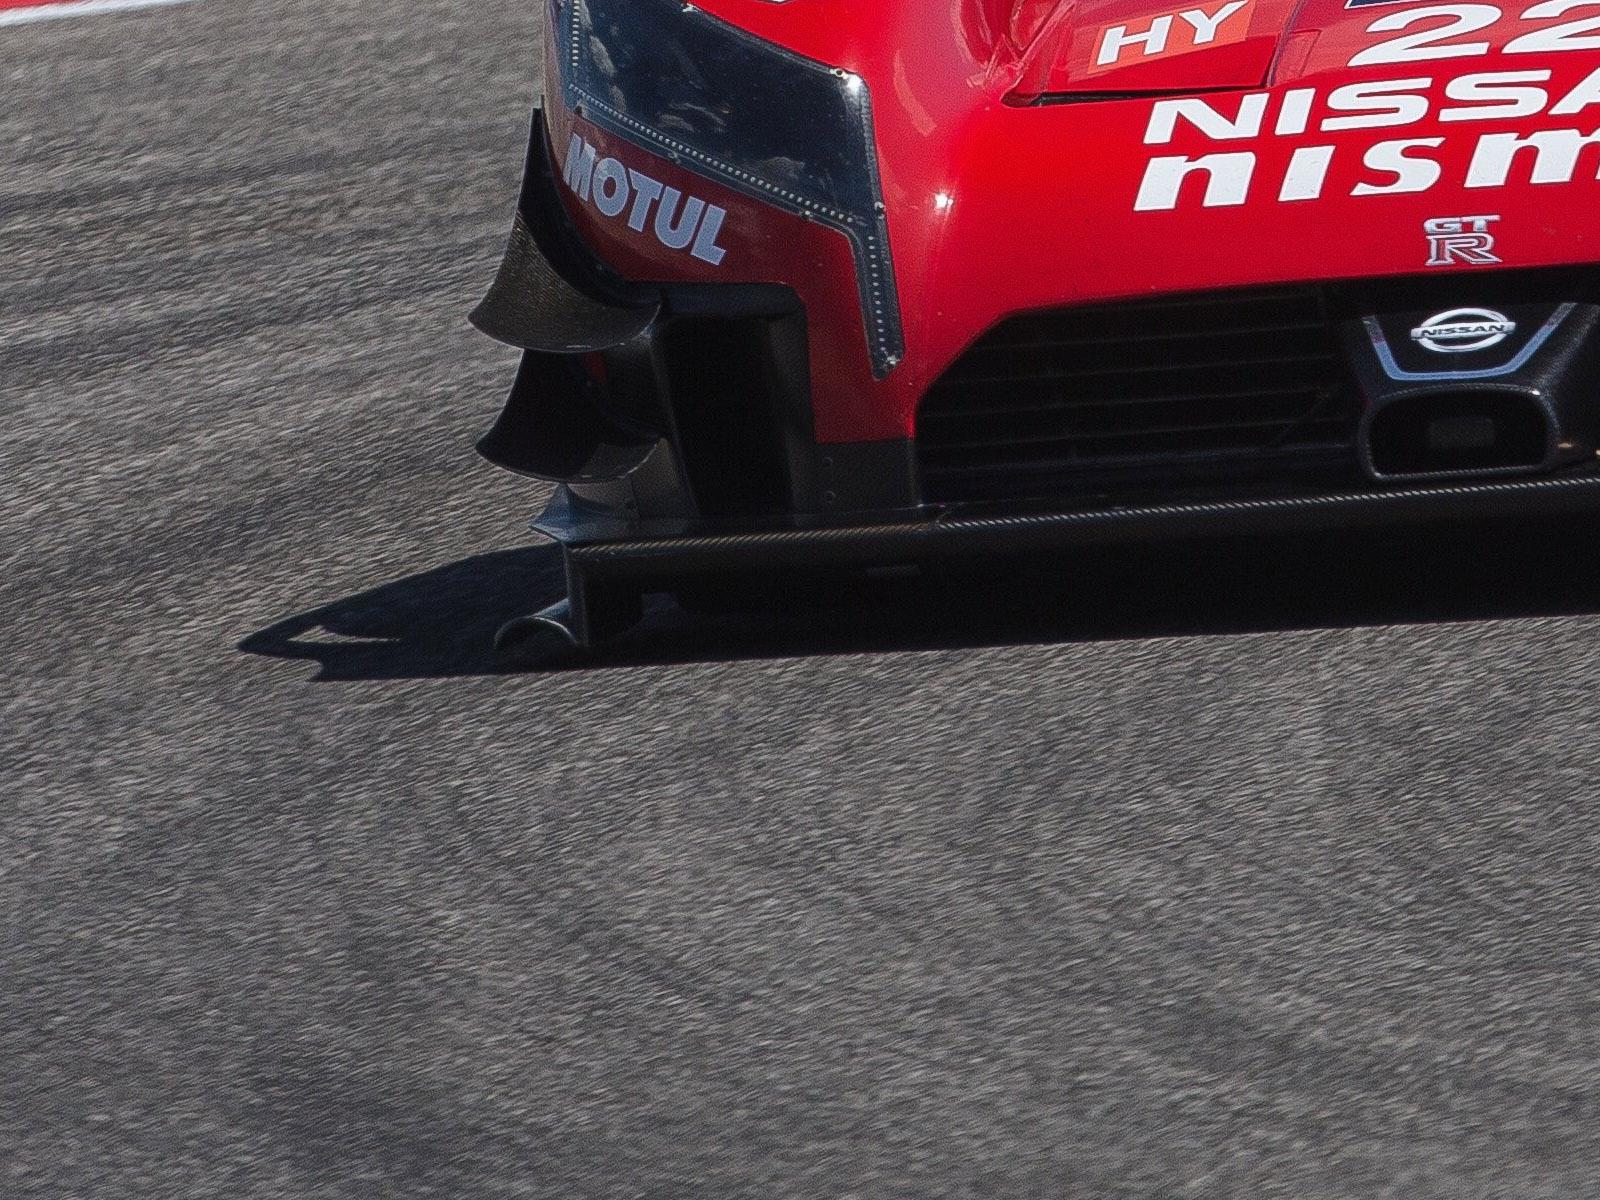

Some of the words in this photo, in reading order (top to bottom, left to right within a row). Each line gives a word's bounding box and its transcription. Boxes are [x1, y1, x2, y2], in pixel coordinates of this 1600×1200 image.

[562, 134, 728, 266] MOTUL
[1423, 214, 1502, 234] GT
[1425, 232, 1504, 267] R
[1420, 323, 1506, 338] NISSAN
